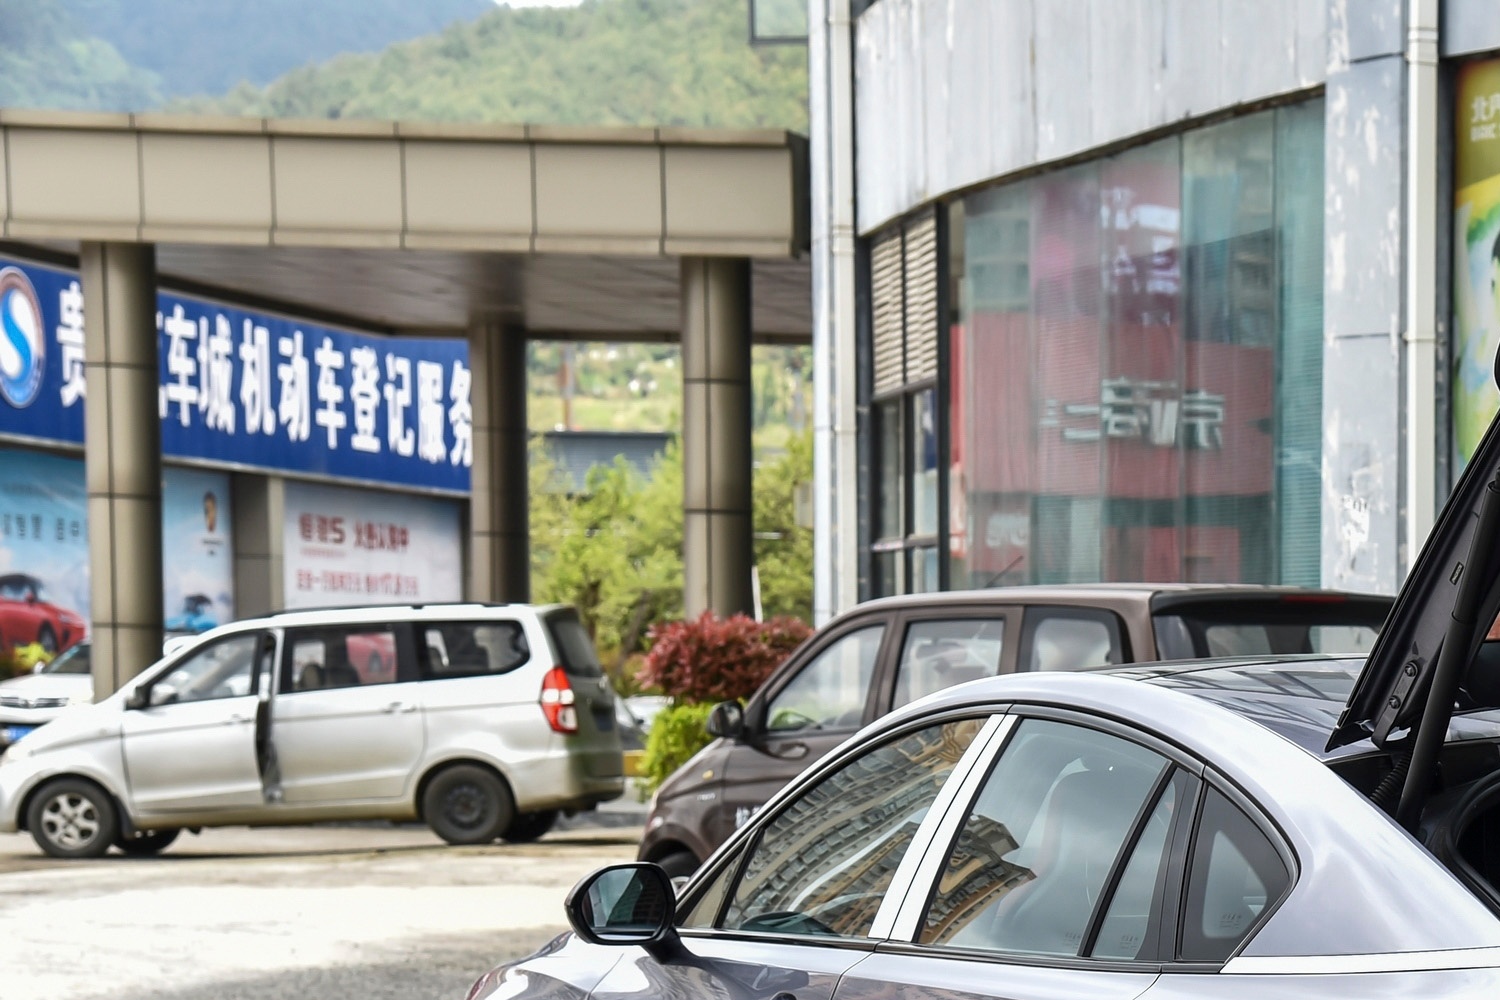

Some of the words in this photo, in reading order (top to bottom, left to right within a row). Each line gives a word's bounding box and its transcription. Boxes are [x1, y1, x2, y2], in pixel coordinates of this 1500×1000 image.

[56, 280, 473, 467] 贵车城机动车登记服务
